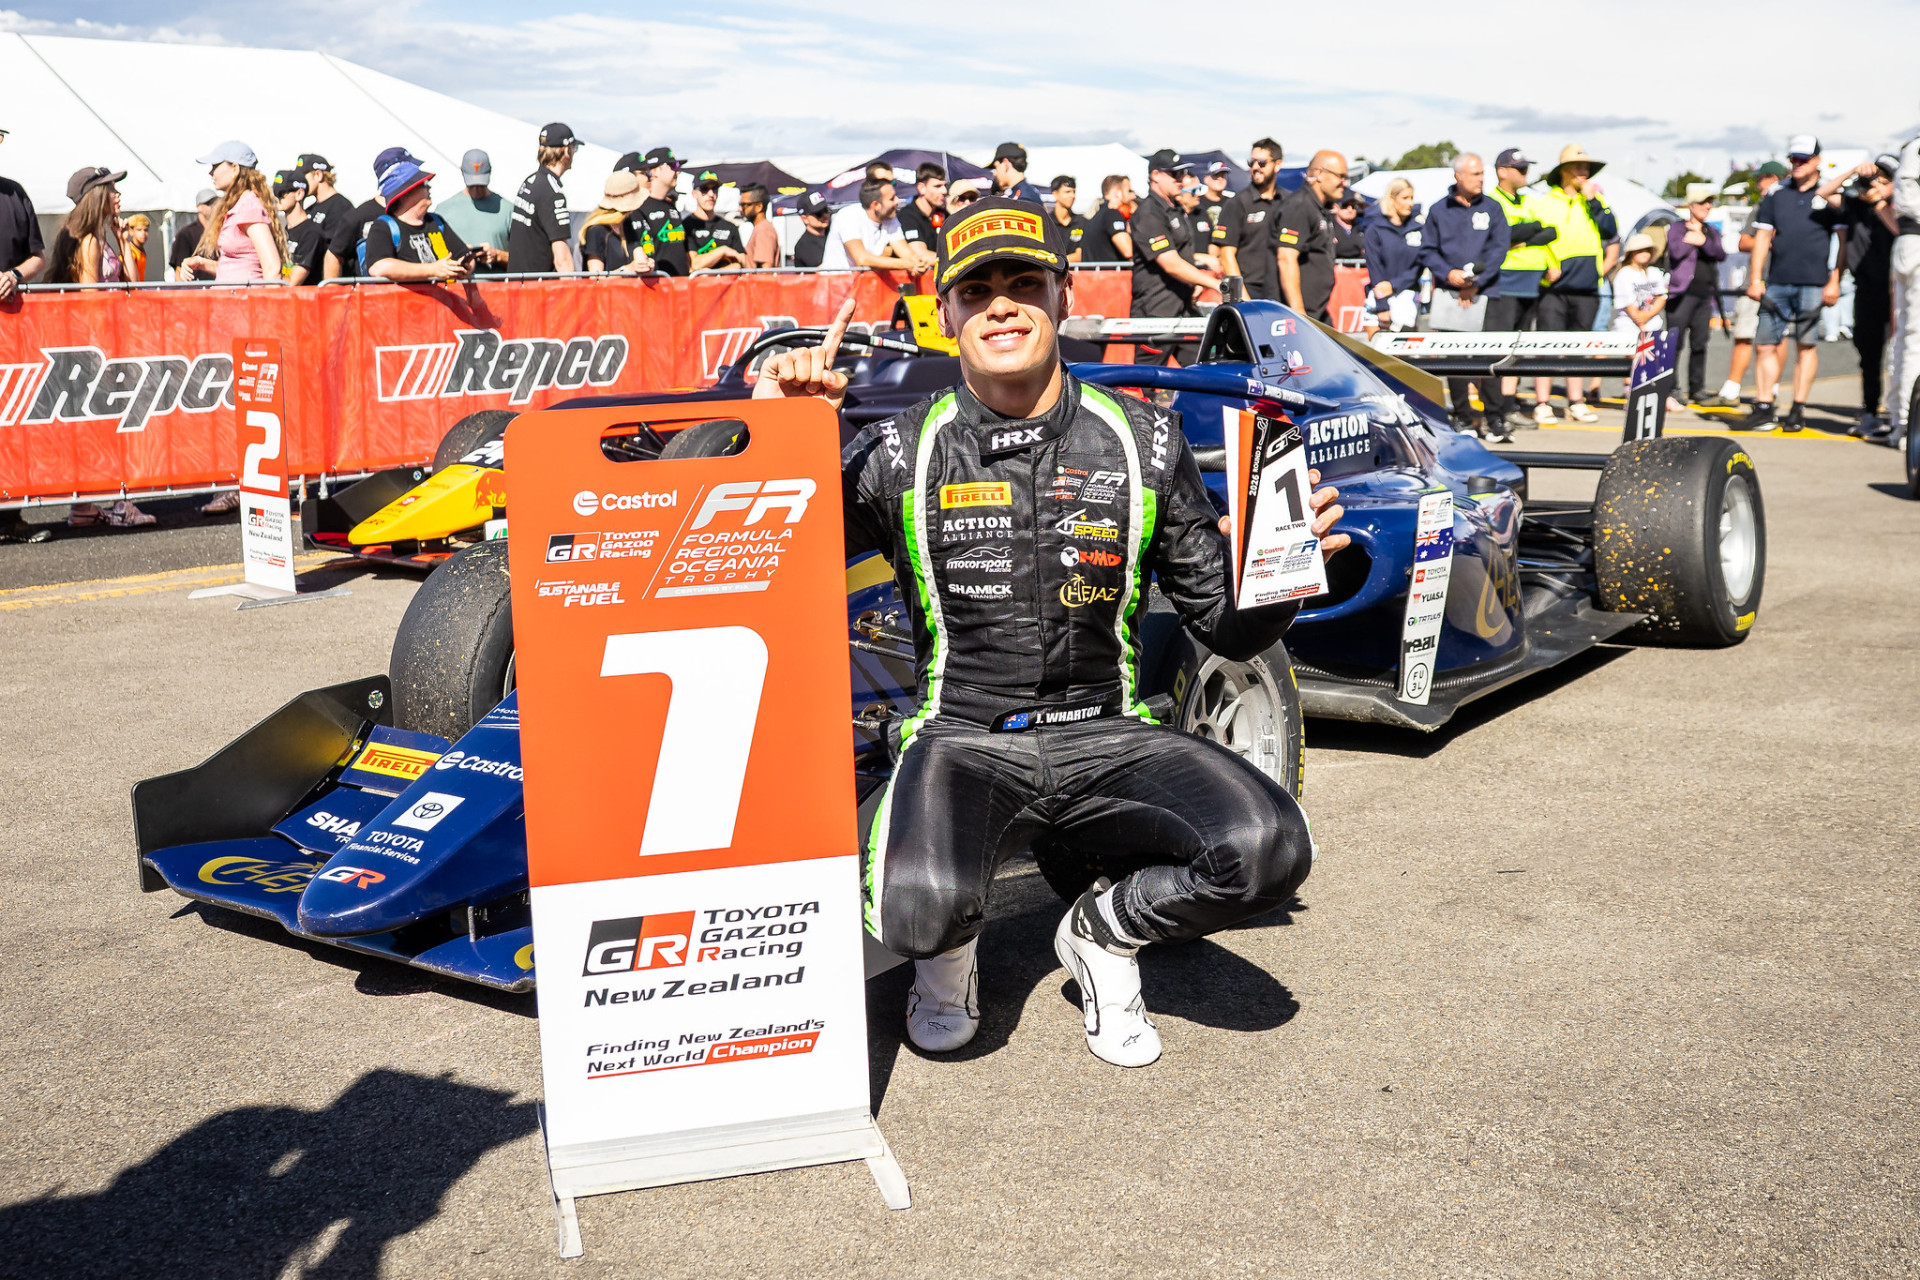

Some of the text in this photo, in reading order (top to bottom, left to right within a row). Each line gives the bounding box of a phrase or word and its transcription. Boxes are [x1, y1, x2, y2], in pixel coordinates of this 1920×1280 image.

[951, 214, 1037, 251] PIRELLI
[1271, 318, 1298, 336] GR
[1429, 341, 1502, 349] TOYOTA
[1508, 341, 1580, 349] GAZOO
[444, 329, 629, 405] Repco
[27, 346, 236, 432] Repc
[1635, 392, 1659, 440] 13
[991, 426, 1044, 450] HRX
[1150, 410, 1169, 470] HRX
[1309, 413, 1369, 446] ACTION
[243, 410, 282, 492] 2
[879, 420, 907, 470] HRX
[1266, 425, 1302, 459] GR
[1310, 439, 1371, 465] ALLIANCE
[1064, 468, 1089, 476] Castrol
[1253, 451, 1261, 473] ROUND
[1089, 471, 1127, 486] FR
[1249, 474, 1260, 496] 2026
[602, 489, 677, 511] Castrol
[690, 478, 817, 530] FR
[946, 486, 1004, 503] PIRELLI
[1274, 468, 1305, 522] 1
[942, 516, 1012, 532] ACTION
[1074, 525, 1119, 539] SPEED
[1275, 521, 1307, 532] RACE TWO
[601, 539, 654, 549] GAZOO
[602, 530, 659, 541] TOYOTA
[682, 528, 793, 546] FORMULA
[943, 530, 1014, 542] ALLIANCE
[547, 543, 596, 561] GR
[600, 548, 651, 559] Racing
[675, 542, 786, 559] REGIONAL
[1079, 549, 1122, 567] HMD
[1264, 546, 1285, 554] Castrol
[1288, 539, 1318, 556] FR
[669, 555, 779, 574] OCEANIA
[946, 559, 1012, 572] motorsport
[665, 569, 776, 584] TROPHY
[538, 582, 620, 597] SUSTAINABLE
[564, 592, 625, 607] FUEL
[675, 586, 720, 595] CERTIFIED
[948, 583, 1013, 595] SHAMICK
[1421, 591, 1444, 603] YUASA
[1405, 635, 1436, 653] real
[1045, 705, 1102, 724] WHARTON
[600, 625, 769, 857] 1
[458, 756, 523, 782] Castro
[306, 811, 361, 837] SHA
[366, 831, 424, 852] TOYOTA
[347, 842, 420, 865] Financial Services
[318, 866, 386, 889] GR
[703, 901, 820, 924] TOYOTA
[700, 921, 808, 944] GAZOO
[585, 935, 690, 974] GR
[697, 940, 802, 963] Racing
[583, 966, 805, 1008] New Zealand
[586, 1019, 825, 1057] Finding New Zealand's
[587, 1035, 813, 1074] Next World Champion
